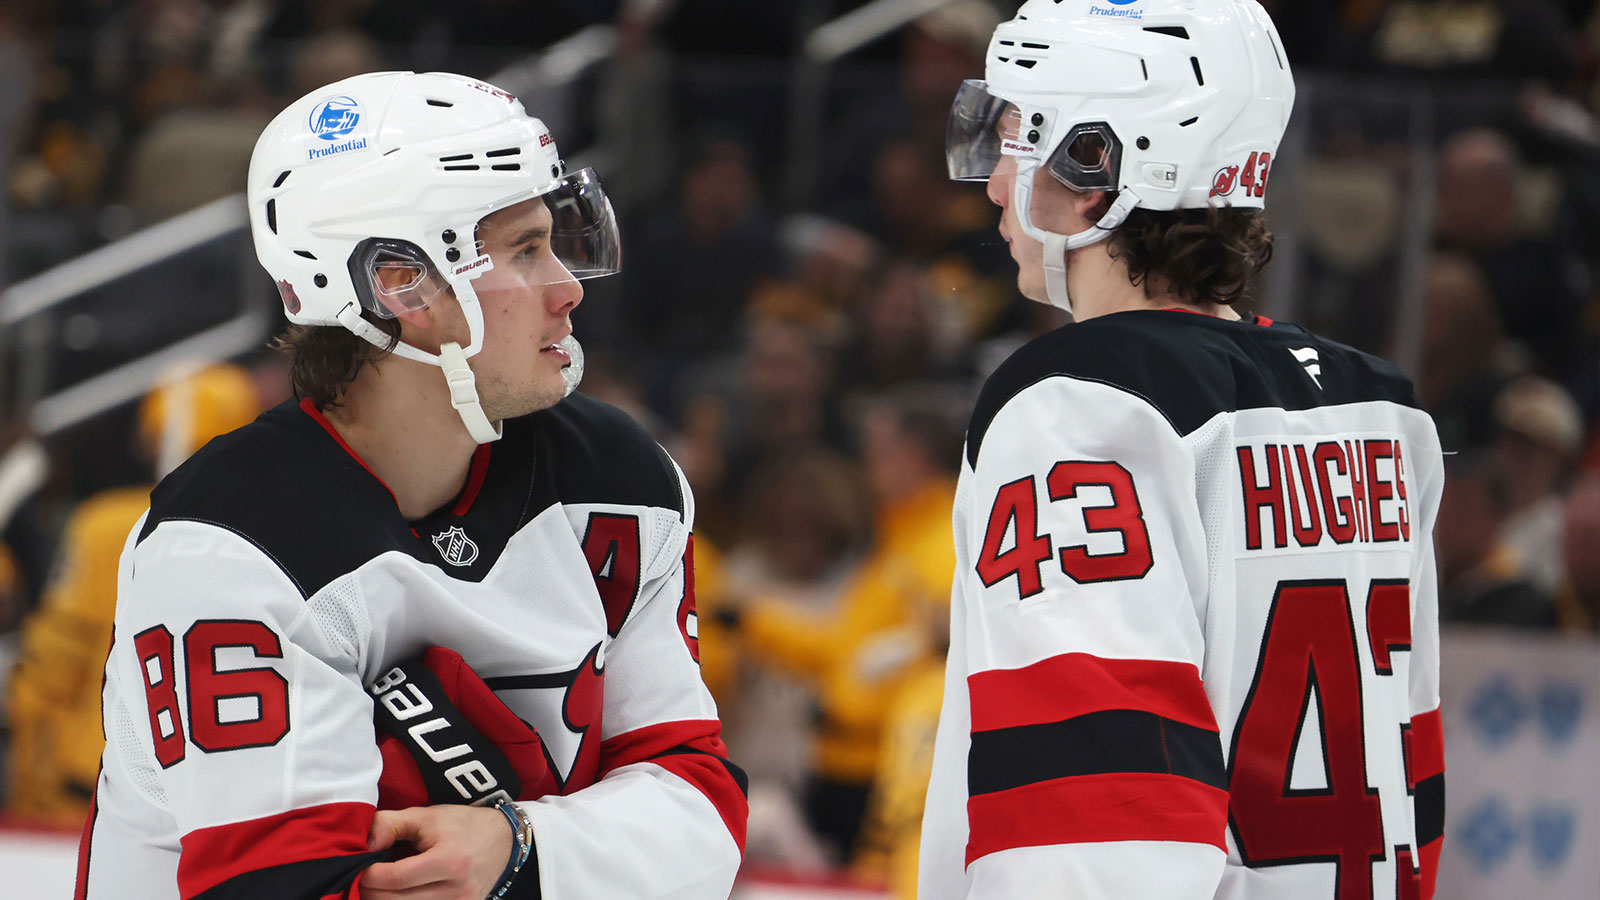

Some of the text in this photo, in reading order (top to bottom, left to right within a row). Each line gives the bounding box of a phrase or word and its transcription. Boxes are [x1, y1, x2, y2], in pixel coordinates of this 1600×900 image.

[1089, 6, 1143, 19] Prudential
[308, 137, 367, 160] Prudential
[1240, 151, 1271, 198] 43
[975, 460, 1155, 600] 43
[1236, 439, 1411, 551] HUGHES
[576, 511, 642, 639] A
[133, 618, 291, 770] 86
